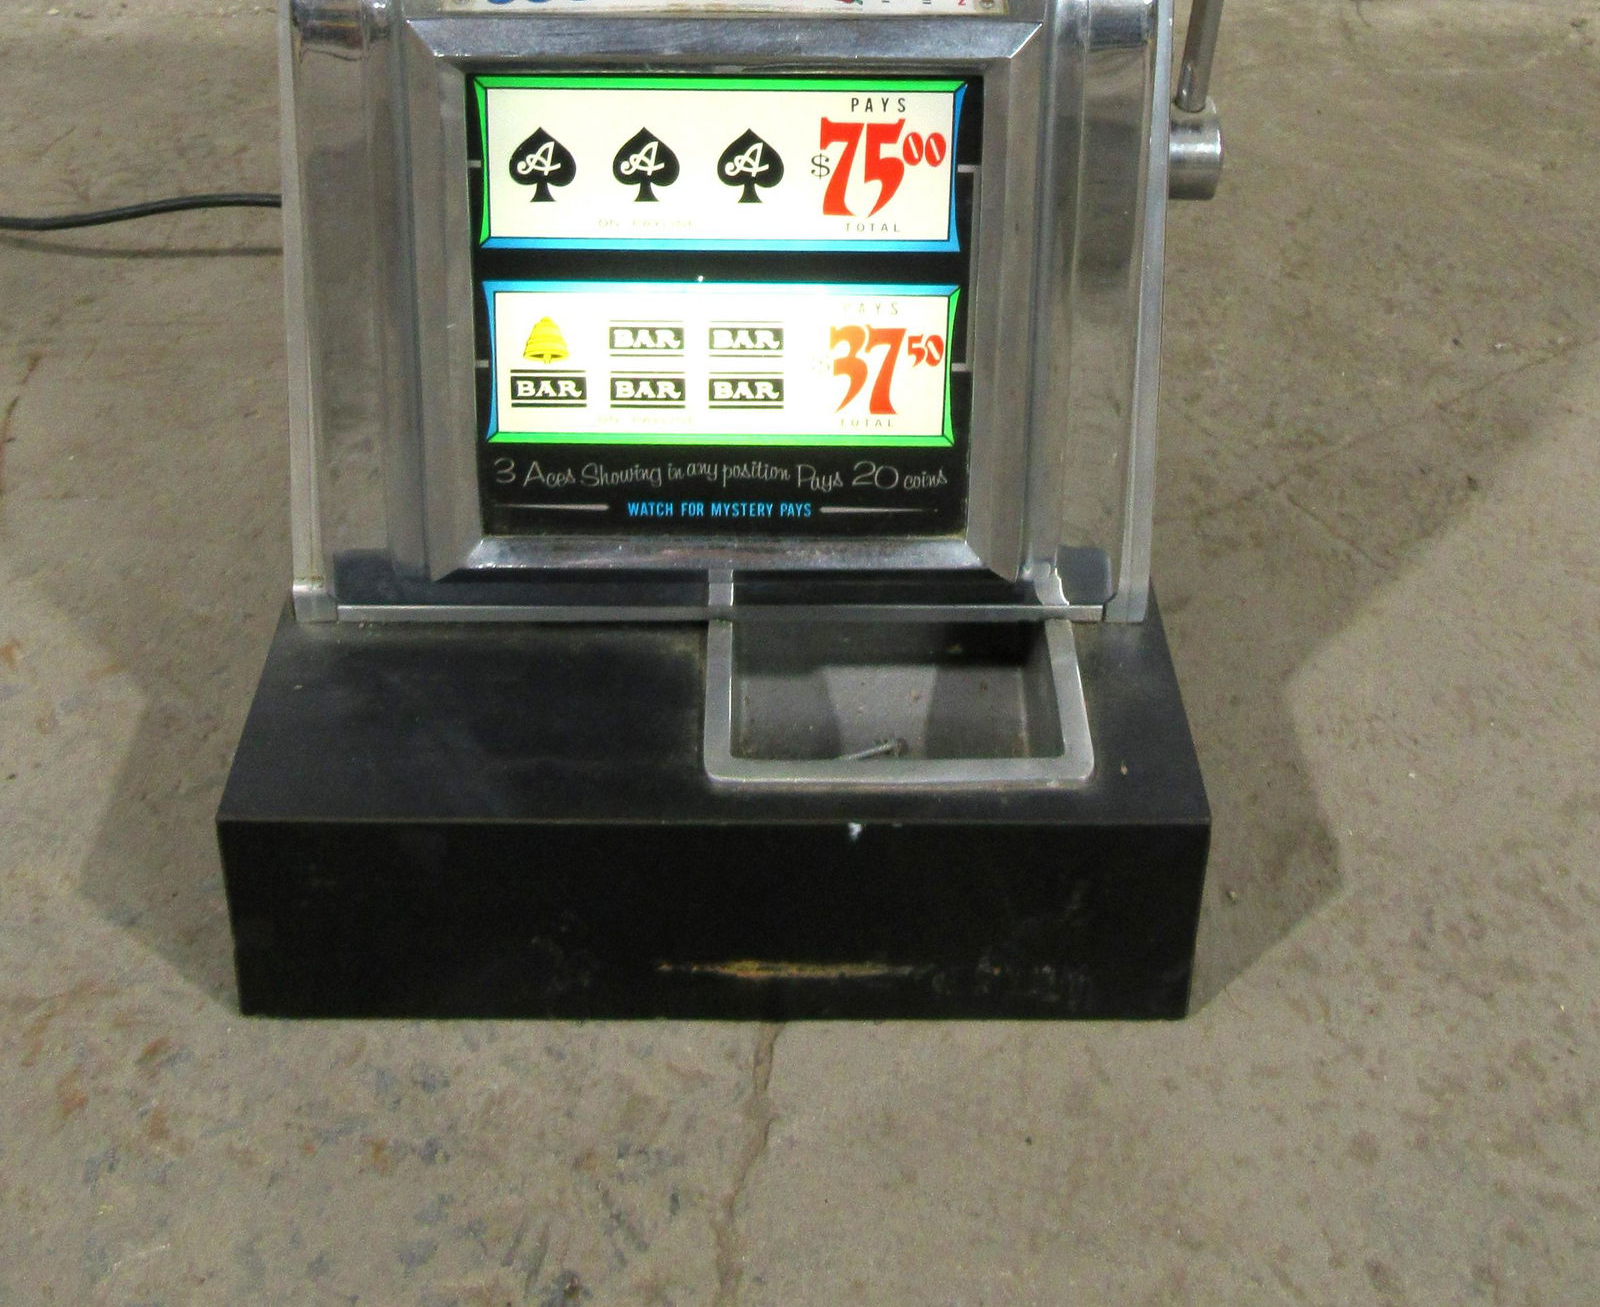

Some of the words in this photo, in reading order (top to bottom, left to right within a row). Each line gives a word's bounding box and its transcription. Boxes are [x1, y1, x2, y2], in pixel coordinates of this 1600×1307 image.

[851, 97, 906, 113] PAYS
[845, 223, 900, 233] TOTAL
[843, 302, 899, 316] AYS
[613, 329, 681, 349] BAR
[712, 329, 780, 349] BAR
[516, 380, 582, 397] BAR
[614, 381, 681, 399] BAR
[713, 381, 780, 399] BAR
[494, 458, 516, 483] 3
[523, 461, 576, 488] Aces
[580, 462, 662, 487] Showing
[667, 462, 684, 480] in
[686, 461, 718, 481] any
[722, 461, 790, 487] position
[796, 464, 843, 492] Pays
[852, 461, 899, 489] 20
[903, 468, 948, 490] coins
[627, 502, 674, 517] WATCH
[681, 502, 704, 517] FOR
[711, 502, 773, 517] MYSTERY
[780, 503, 812, 517] PAYS
